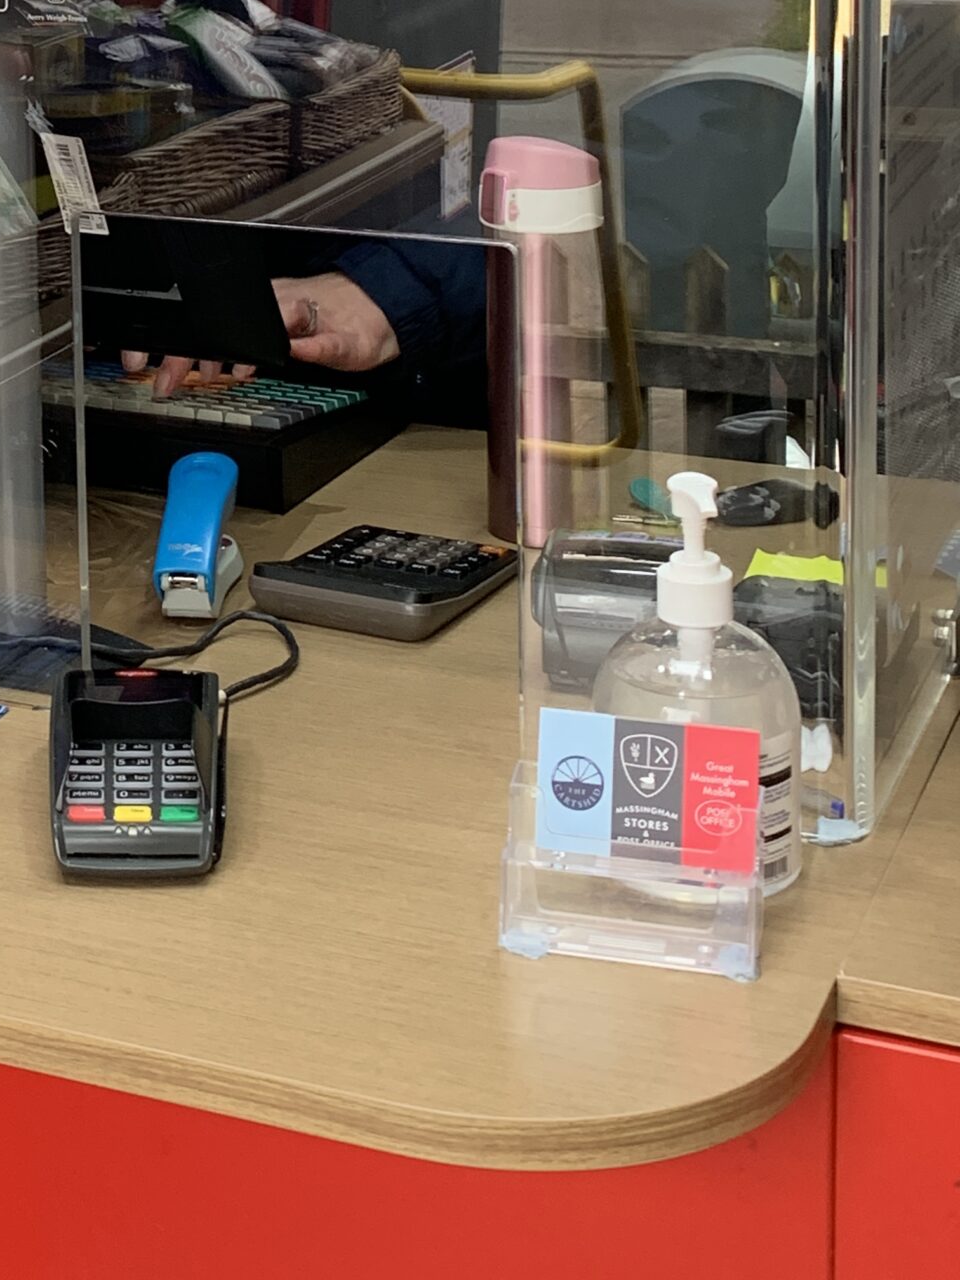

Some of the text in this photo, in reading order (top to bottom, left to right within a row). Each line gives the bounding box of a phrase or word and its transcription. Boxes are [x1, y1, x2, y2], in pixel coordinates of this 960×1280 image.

[706, 761, 734, 773] Great
[690, 772, 750, 788] Massingham
[702, 786, 737, 799] Mobile
[616, 805, 679, 820] MASSINGHAM
[706, 806, 731, 817] POST
[624, 817, 669, 831] STORES
[700, 815, 735, 829] OFFICE
